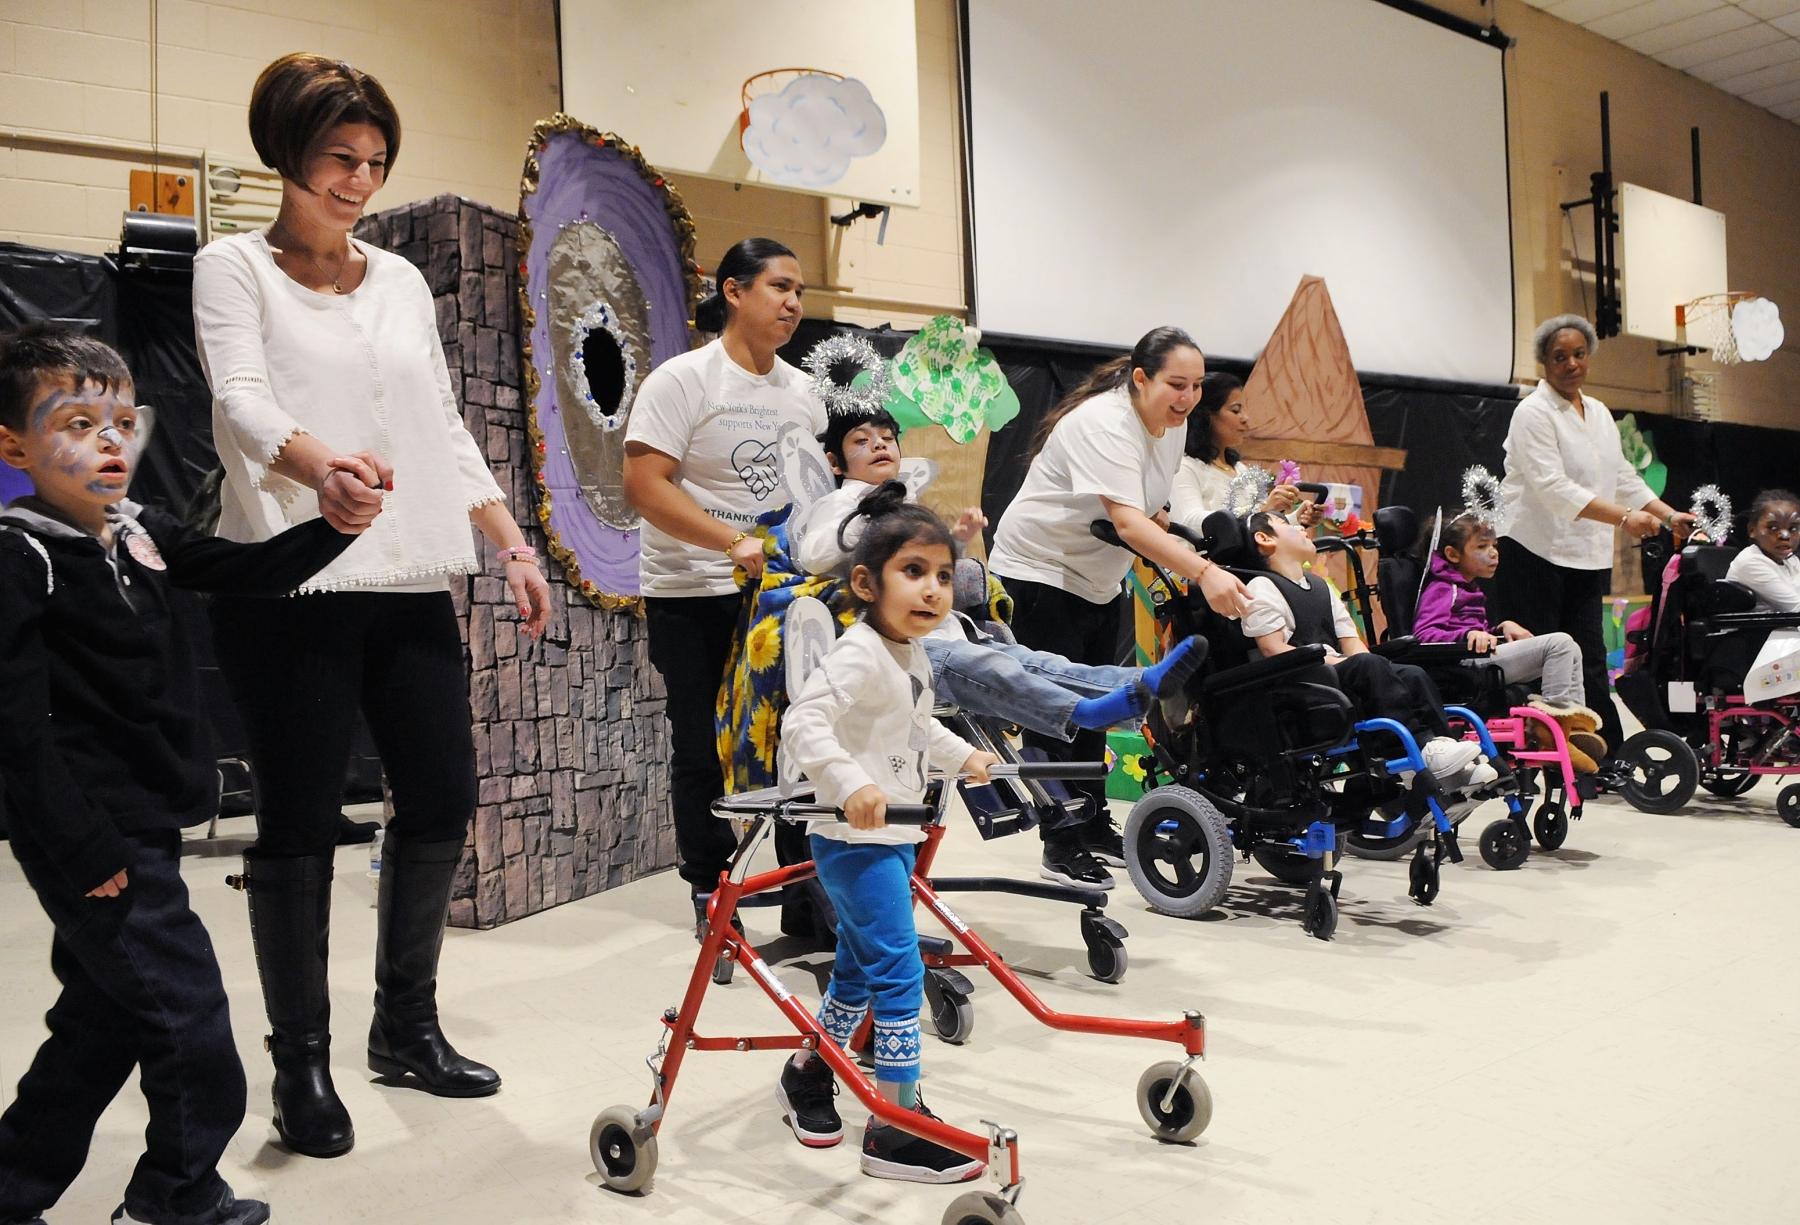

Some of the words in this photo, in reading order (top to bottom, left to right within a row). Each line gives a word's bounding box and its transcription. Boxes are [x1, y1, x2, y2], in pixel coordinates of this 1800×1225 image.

[707, 401, 725, 411] New
[749, 404, 778, 418] Brightest
[719, 419, 752, 431] supports
[755, 420, 771, 431] New
